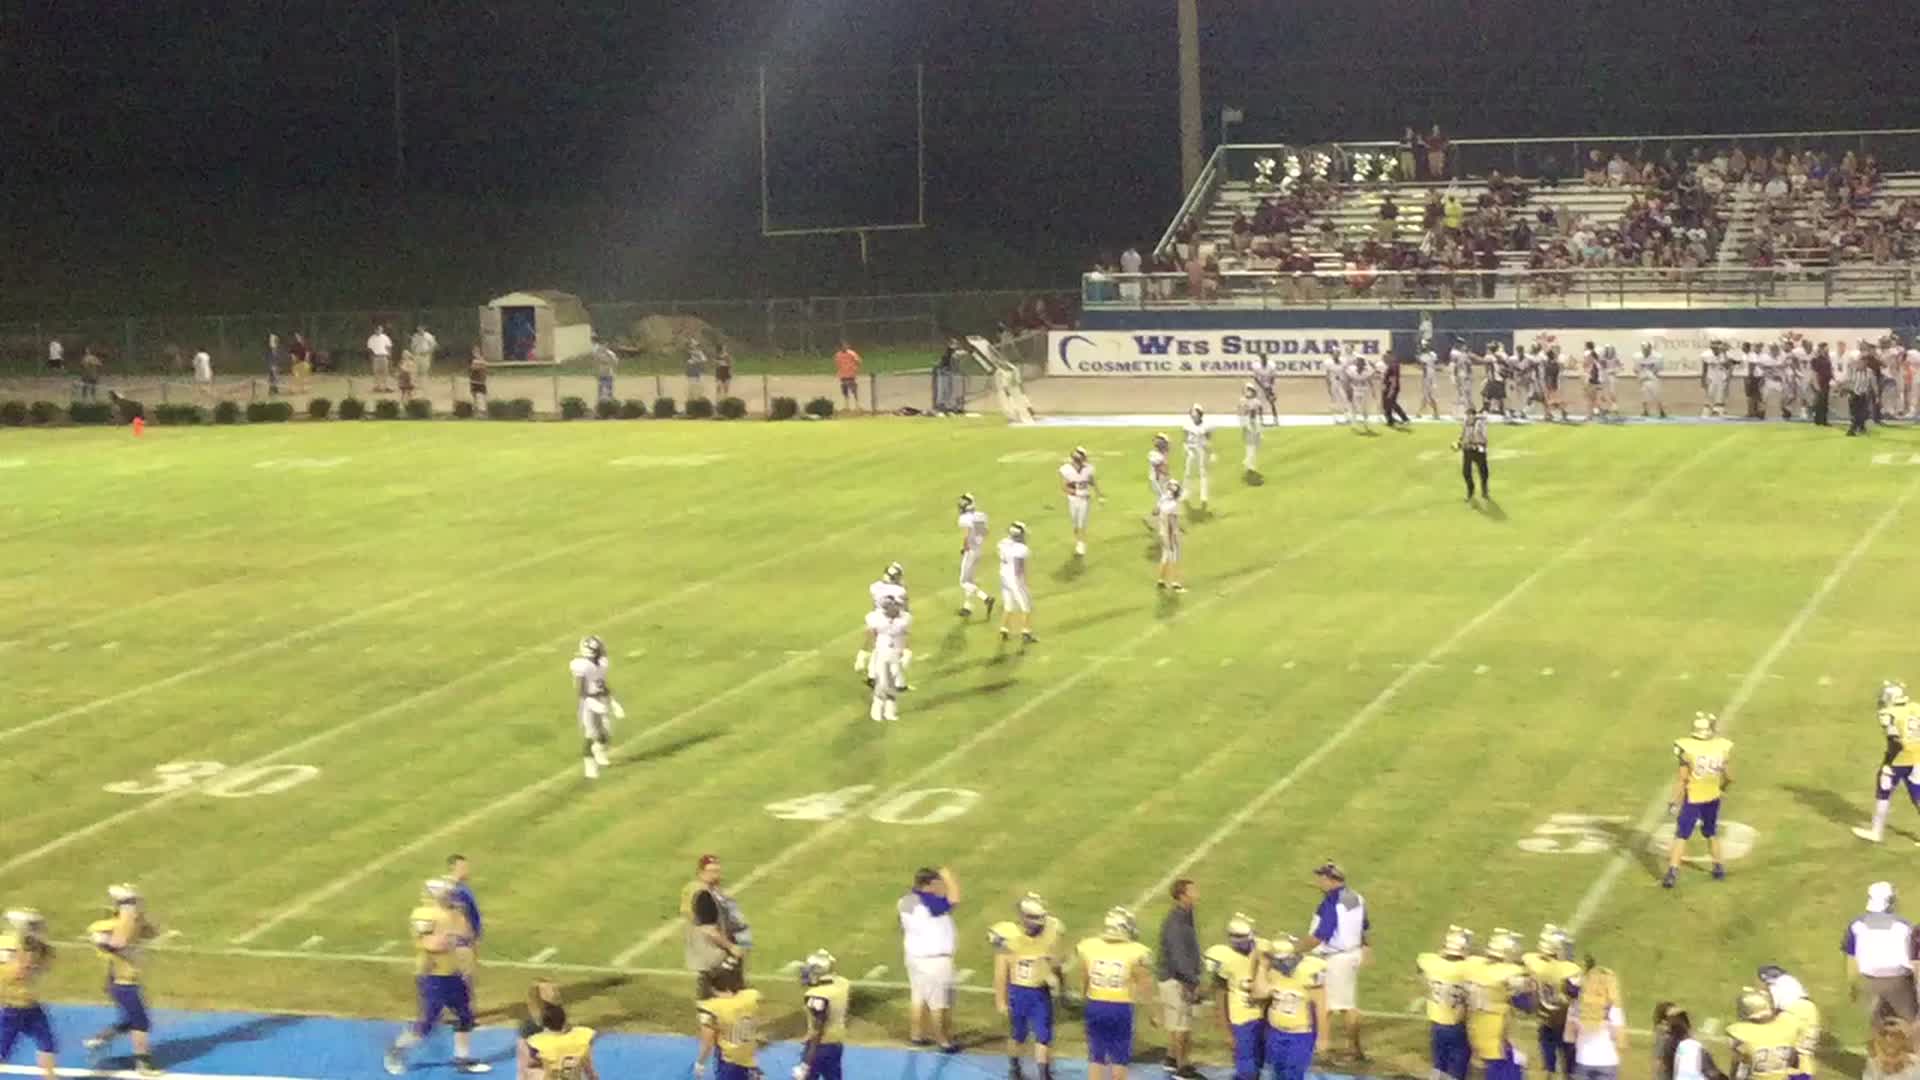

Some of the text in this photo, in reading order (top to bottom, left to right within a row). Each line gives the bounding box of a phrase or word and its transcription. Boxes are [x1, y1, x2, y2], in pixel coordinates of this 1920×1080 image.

[1133, 335, 1210, 355] WES
[1077, 360, 1172, 373] COSMETIC
[1200, 360, 1259, 373] FAMIL
[763, 783, 982, 825] 40
